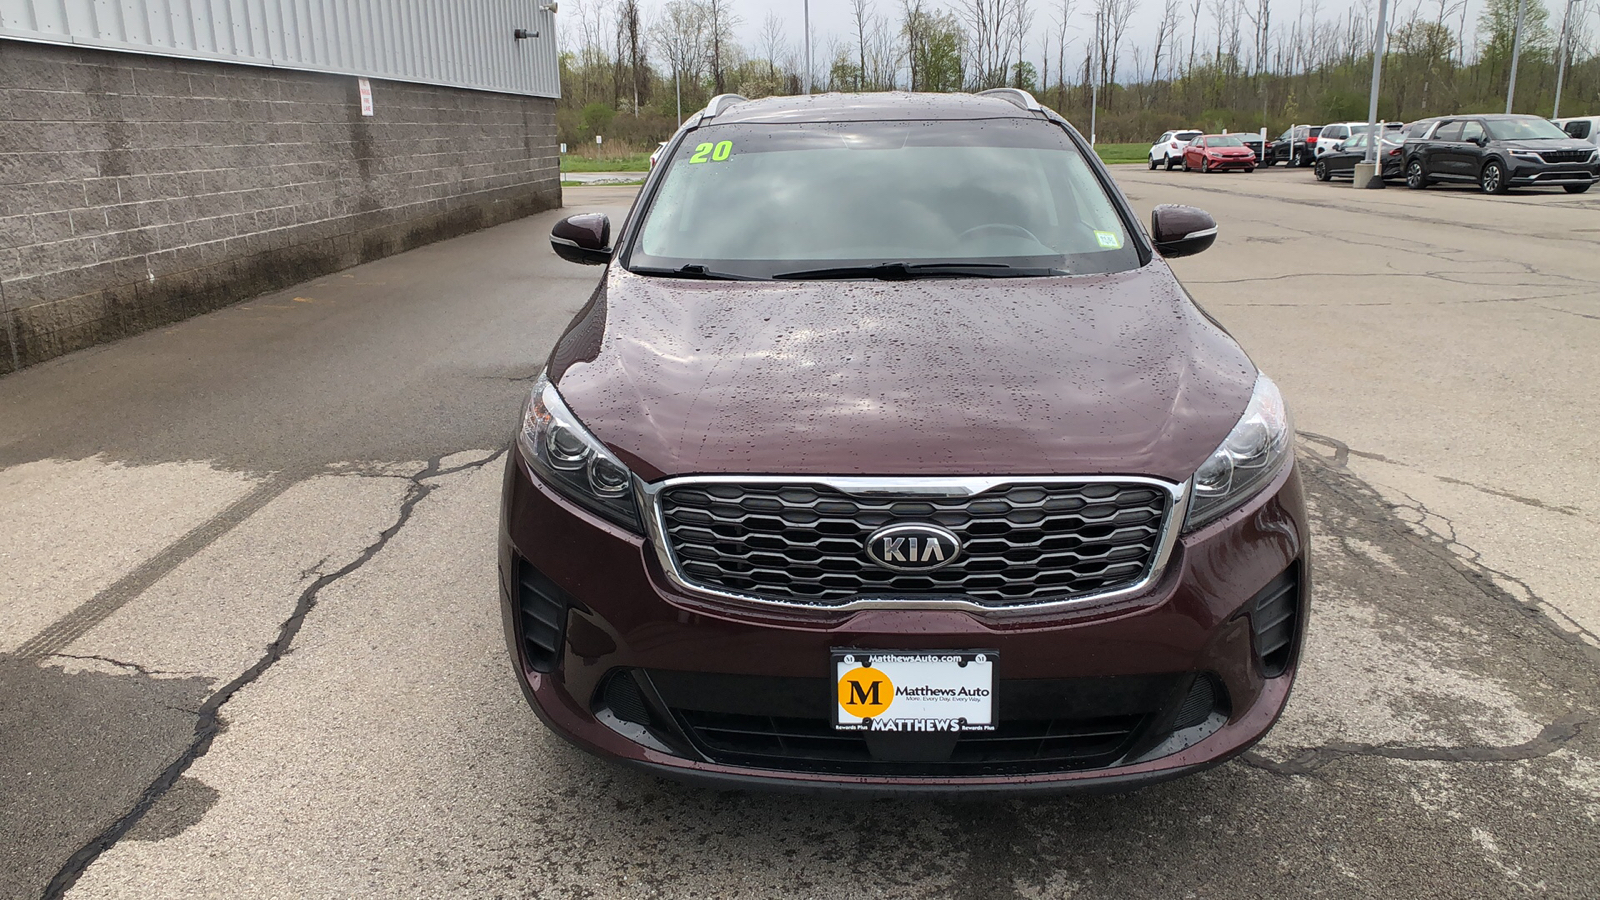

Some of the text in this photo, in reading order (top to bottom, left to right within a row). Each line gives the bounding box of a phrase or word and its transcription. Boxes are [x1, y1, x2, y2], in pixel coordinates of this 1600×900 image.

[688, 140, 733, 164] 20
[883, 537, 945, 562] KIA
[868, 653, 962, 663] MatthewsAuto.com
[846, 680, 883, 705] M
[895, 685, 990, 697] Matthews Auto
[870, 718, 960, 732] MATTHEWS
